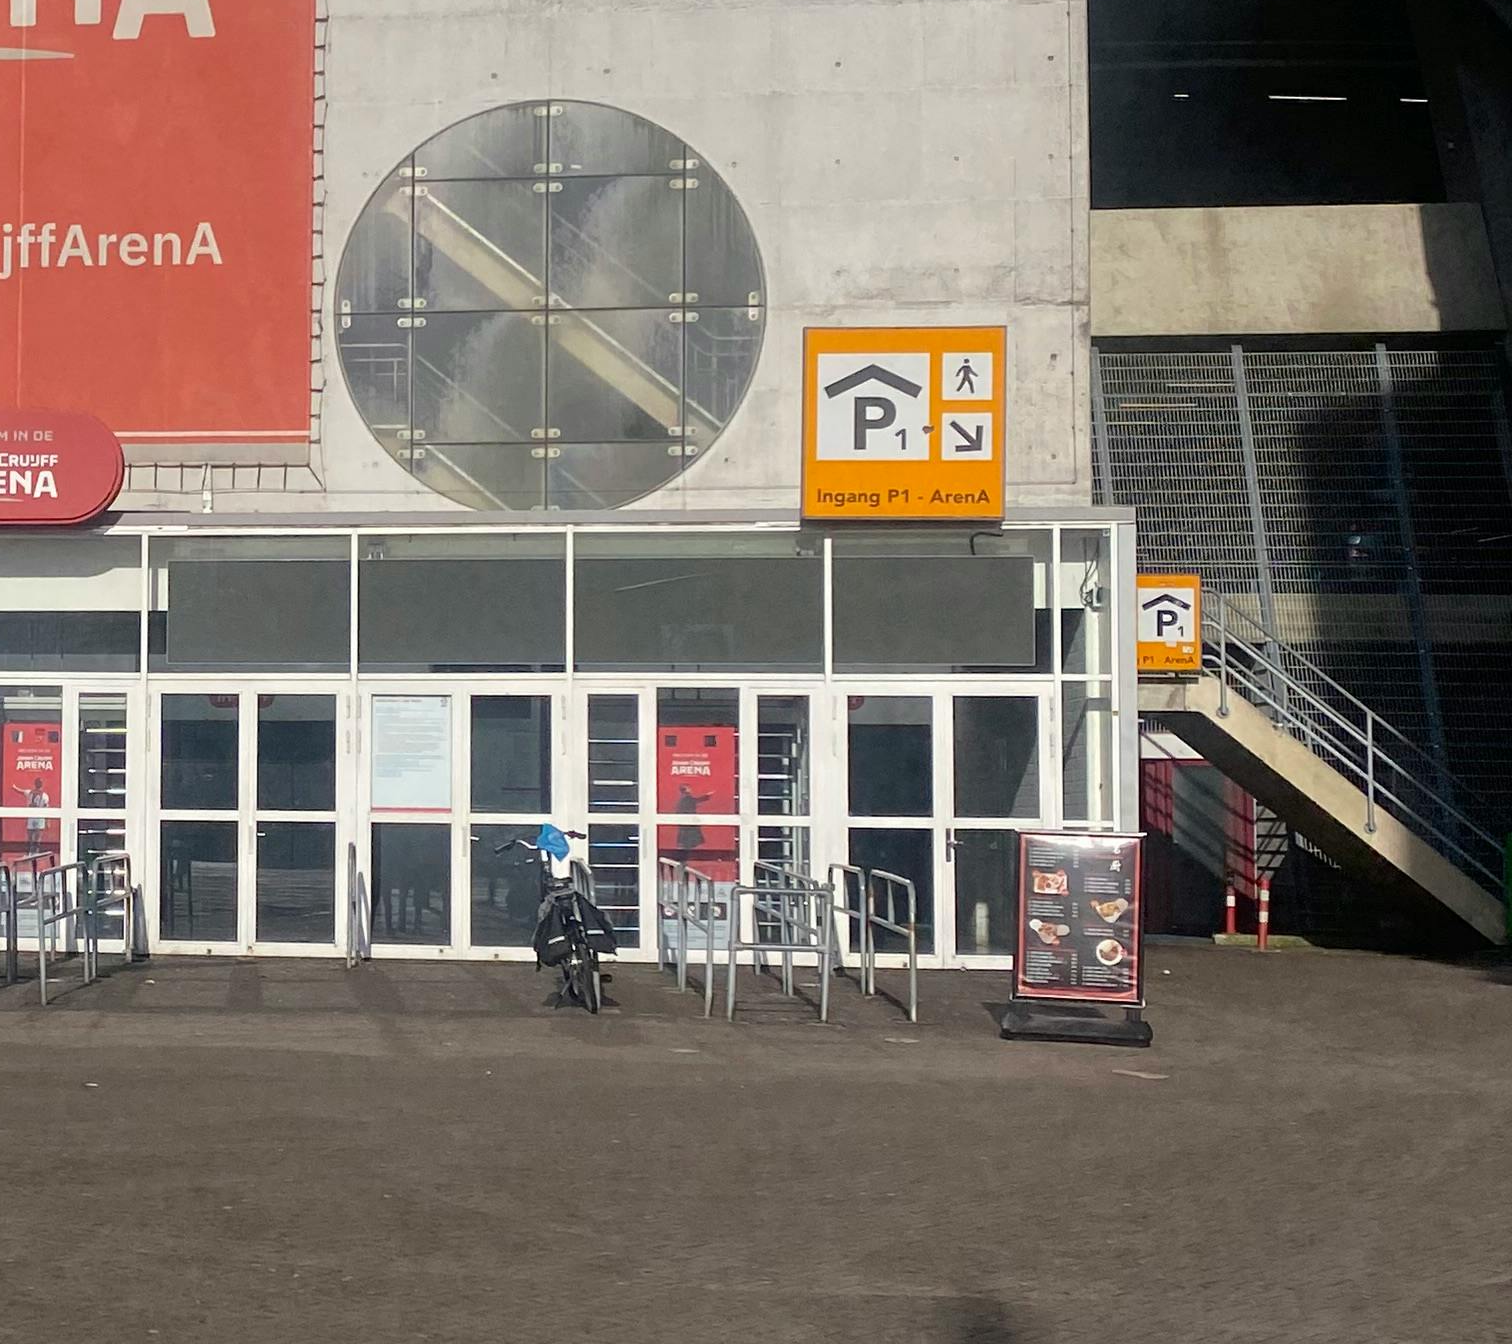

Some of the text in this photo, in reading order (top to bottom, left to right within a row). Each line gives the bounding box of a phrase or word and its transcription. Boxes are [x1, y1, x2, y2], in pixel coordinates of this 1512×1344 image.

[13, 430, 28, 441] IN
[33, 430, 54, 441] DE
[817, 489, 880, 507] Ingang
[888, 489, 910, 503] P1
[929, 489, 990, 504] ArenA
[1163, 656, 1196, 664] ArenA
